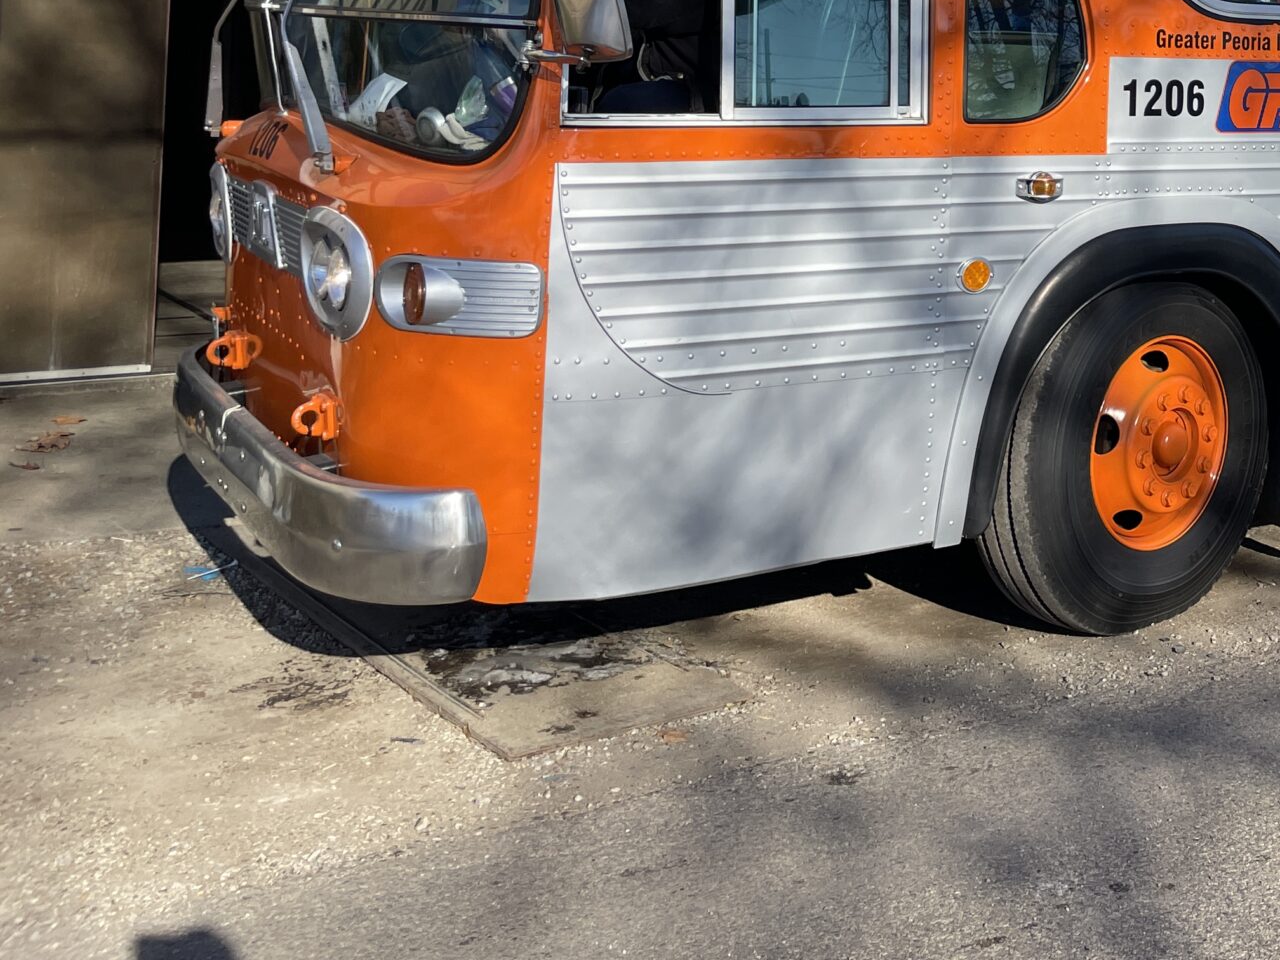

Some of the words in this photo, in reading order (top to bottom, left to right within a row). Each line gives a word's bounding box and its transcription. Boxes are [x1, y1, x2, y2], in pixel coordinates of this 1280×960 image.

[1156, 29, 1217, 49] Greater
[1222, 31, 1271, 50] Peoria
[1123, 79, 1205, 117] 1206
[248, 119, 288, 160] 1206
